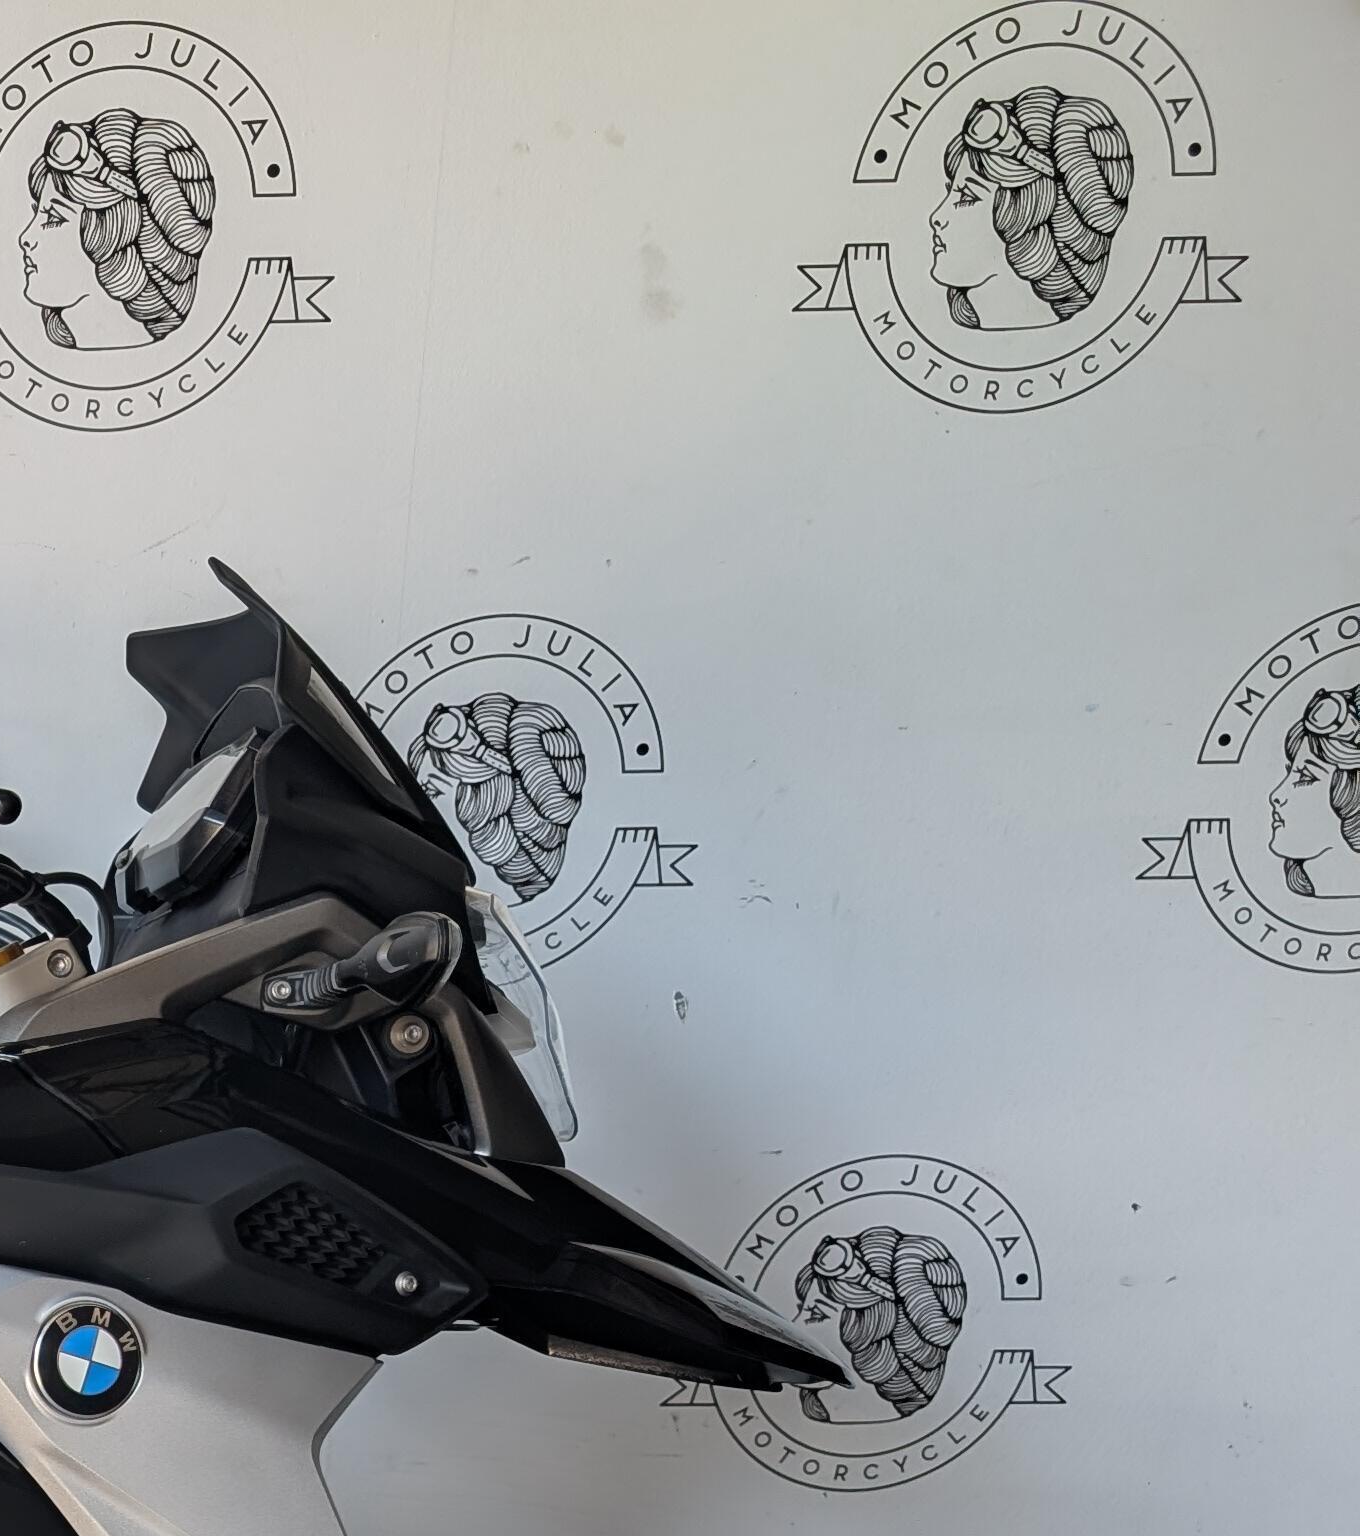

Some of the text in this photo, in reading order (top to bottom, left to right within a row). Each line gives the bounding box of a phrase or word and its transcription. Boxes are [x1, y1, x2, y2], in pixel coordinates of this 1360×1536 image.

[135, 33, 268, 145] JULIA
[890, 10, 1193, 129] MOTO JULIA
[874, 304, 1156, 400] MOTORCYCLE
[514, 624, 639, 726] JULIA
[1234, 615, 1360, 716] MOTO
[1213, 879, 1360, 961] MOTORC
[746, 1164, 1020, 1260] MOTO JULIA
[55, 1307, 137, 1353] BMW
[733, 1406, 990, 1481] MOTORCYCLE
